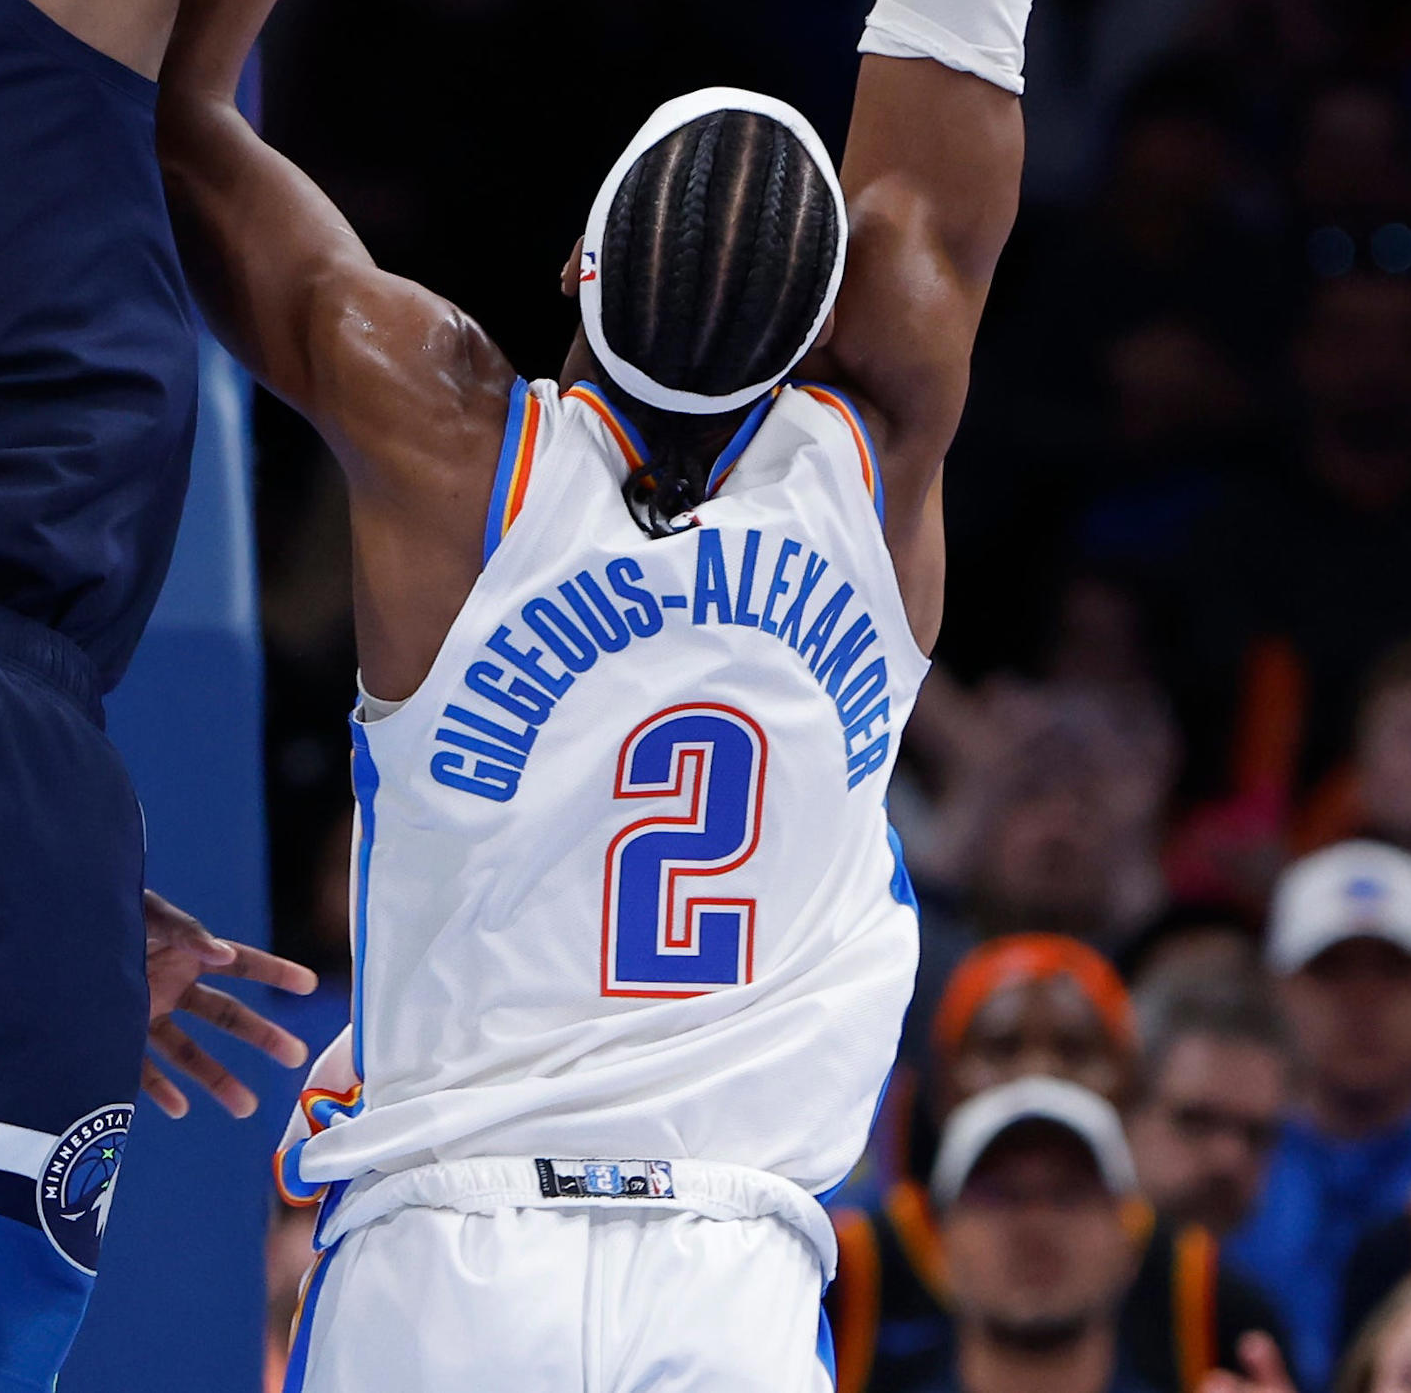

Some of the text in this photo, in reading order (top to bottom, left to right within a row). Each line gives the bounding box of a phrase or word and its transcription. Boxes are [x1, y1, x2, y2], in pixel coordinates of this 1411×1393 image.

[429, 528, 892, 804] GILGEOUS-ALEXANDER
[600, 701, 770, 998] 2
[44, 1113, 124, 1200] MINNESOTA
